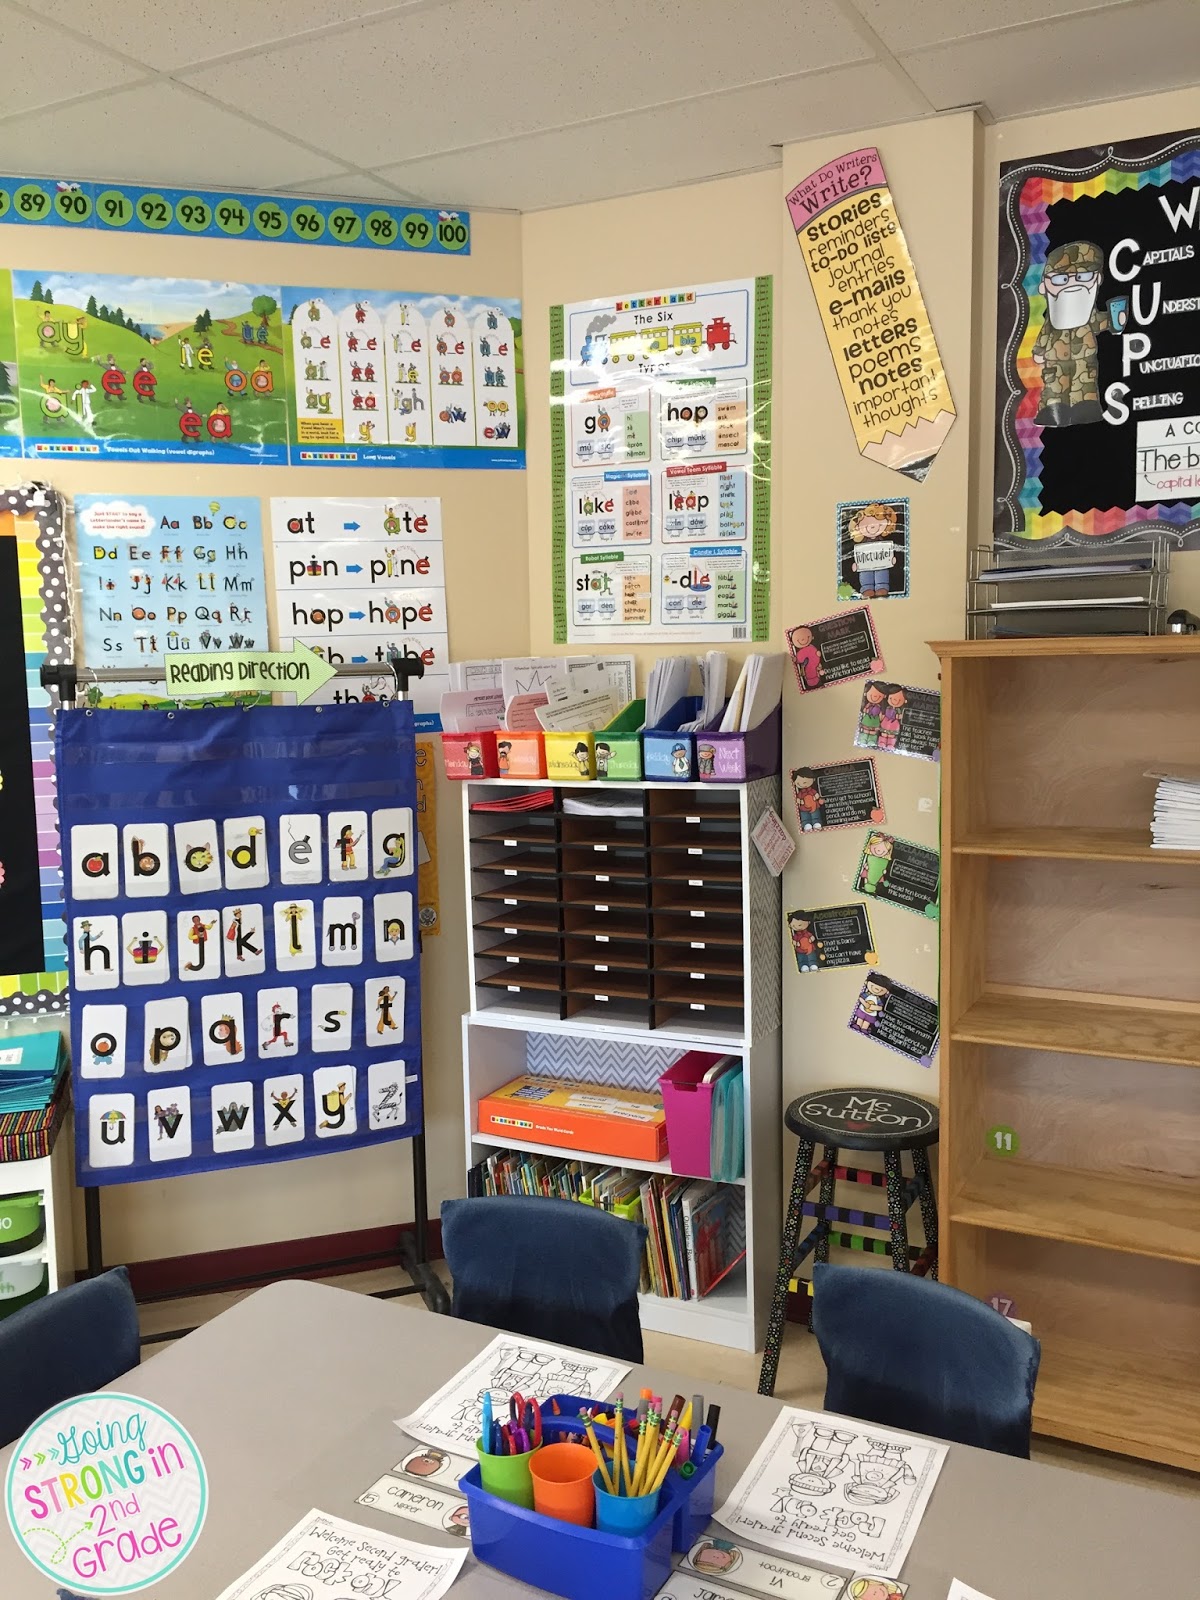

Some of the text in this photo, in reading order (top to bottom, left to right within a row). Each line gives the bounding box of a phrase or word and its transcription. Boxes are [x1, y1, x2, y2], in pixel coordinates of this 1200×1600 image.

[788, 153, 878, 206] What Do Writers
[799, 165, 873, 214] Write?
[20, 192, 45, 212] 89
[60, 195, 87, 215] 90
[104, 199, 124, 218] 91
[141, 201, 167, 221] 92
[181, 204, 206, 224] 93
[219, 207, 244, 226] 94
[258, 210, 282, 230] 95
[296, 213, 320, 232] 96
[333, 215, 356, 234] 97
[370, 218, 393, 238] 98
[405, 221, 429, 240] 99
[439, 224, 467, 243] 100
[808, 208, 890, 261] reminders
[863, 221, 897, 249] lists
[828, 242, 886, 288] journal
[838, 255, 895, 293] entries
[615, 291, 694, 312] Letterland
[829, 269, 906, 316] e-mails
[634, 311, 674, 325] The Six
[832, 285, 912, 331] thank you
[852, 309, 899, 340] notes
[848, 335, 922, 384] poems
[858, 357, 923, 396] notes
[852, 368, 937, 416] important
[667, 402, 709, 424] hop
[863, 387, 938, 428] thoughts
[584, 412, 611, 434] go
[1137, 448, 1182, 472] The
[578, 496, 615, 516] lake
[669, 493, 710, 512] leap
[287, 510, 429, 536] at ate
[289, 553, 431, 585] pin pine
[291, 600, 433, 632] hop hope
[718, 747, 740, 760] Next
[719, 761, 742, 774] Week
[805, 1103, 922, 1128] Sutton
[846, 1096, 892, 1113] Ms
[994, 1131, 1012, 1151] 11
[991, 1297, 1013, 1316] 17
[360, 1492, 378, 1503] 15
[735, 1514, 886, 1562] Welcome Second grader!
[774, 1514, 857, 1543] Get ready to
[308, 1526, 444, 1577] Welcome Second grader!
[326, 1545, 401, 1578] Get ready to
[768, 1575, 784, 1588] Vi
